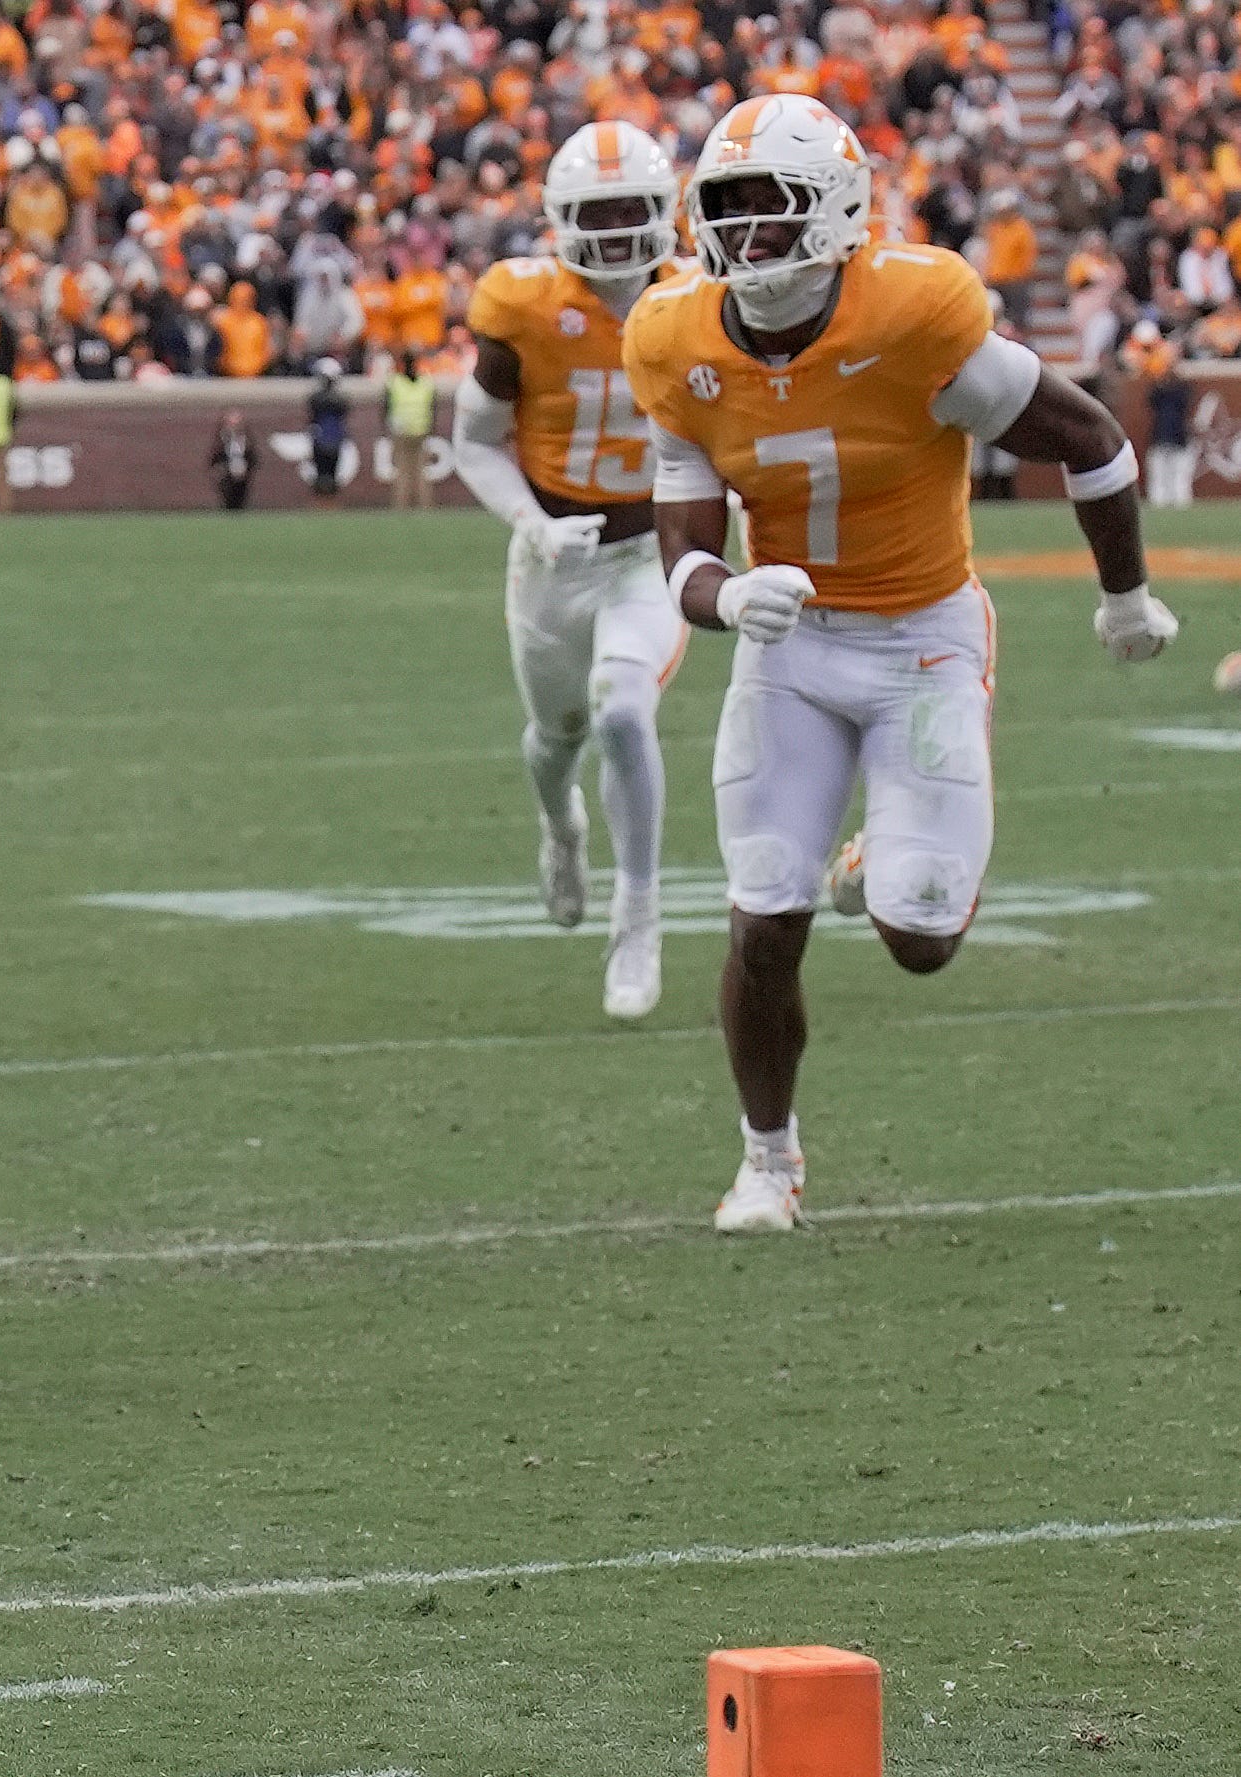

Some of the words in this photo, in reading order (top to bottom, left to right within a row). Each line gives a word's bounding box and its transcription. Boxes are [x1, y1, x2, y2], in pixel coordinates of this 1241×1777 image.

[567, 368, 656, 494] 15
[768, 376, 793, 401] T
[755, 427, 840, 565] 7
